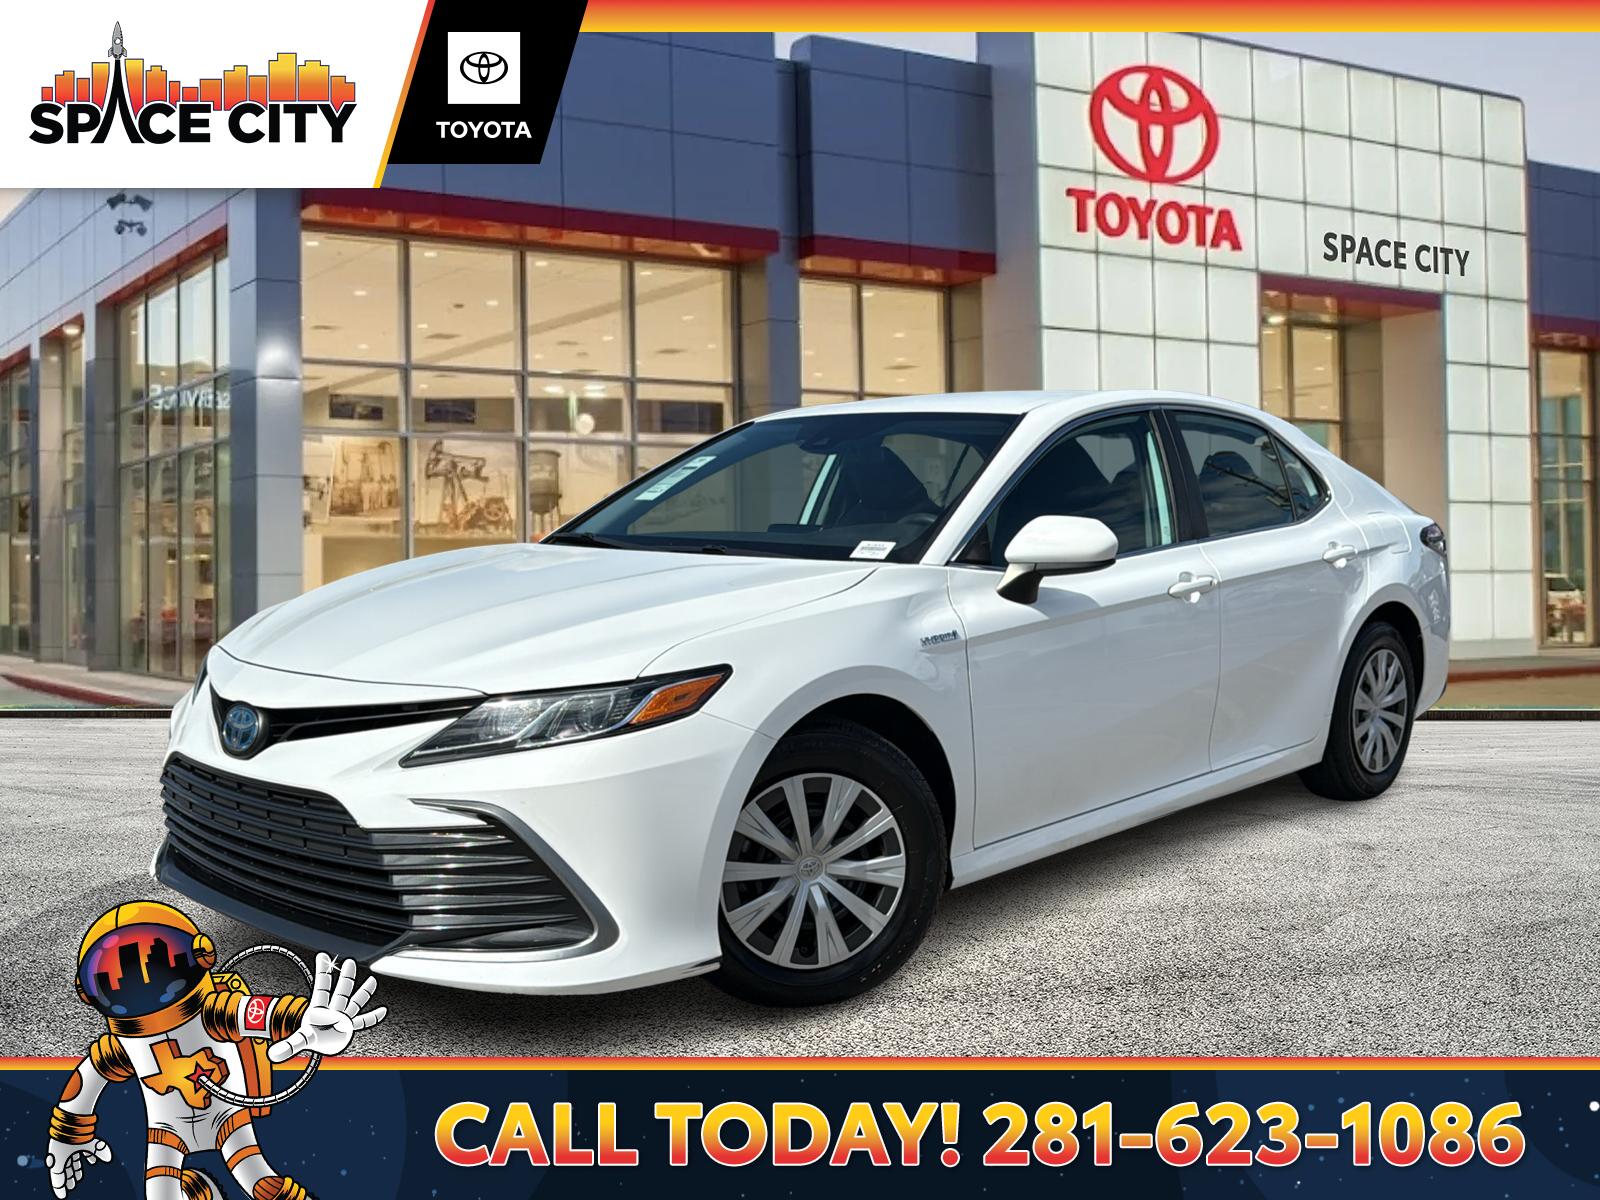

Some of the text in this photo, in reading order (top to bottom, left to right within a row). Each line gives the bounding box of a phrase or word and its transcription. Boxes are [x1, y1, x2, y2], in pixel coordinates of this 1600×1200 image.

[1066, 187, 1243, 252] TOYOTA
[1322, 232, 1471, 277] SPACE CITY
